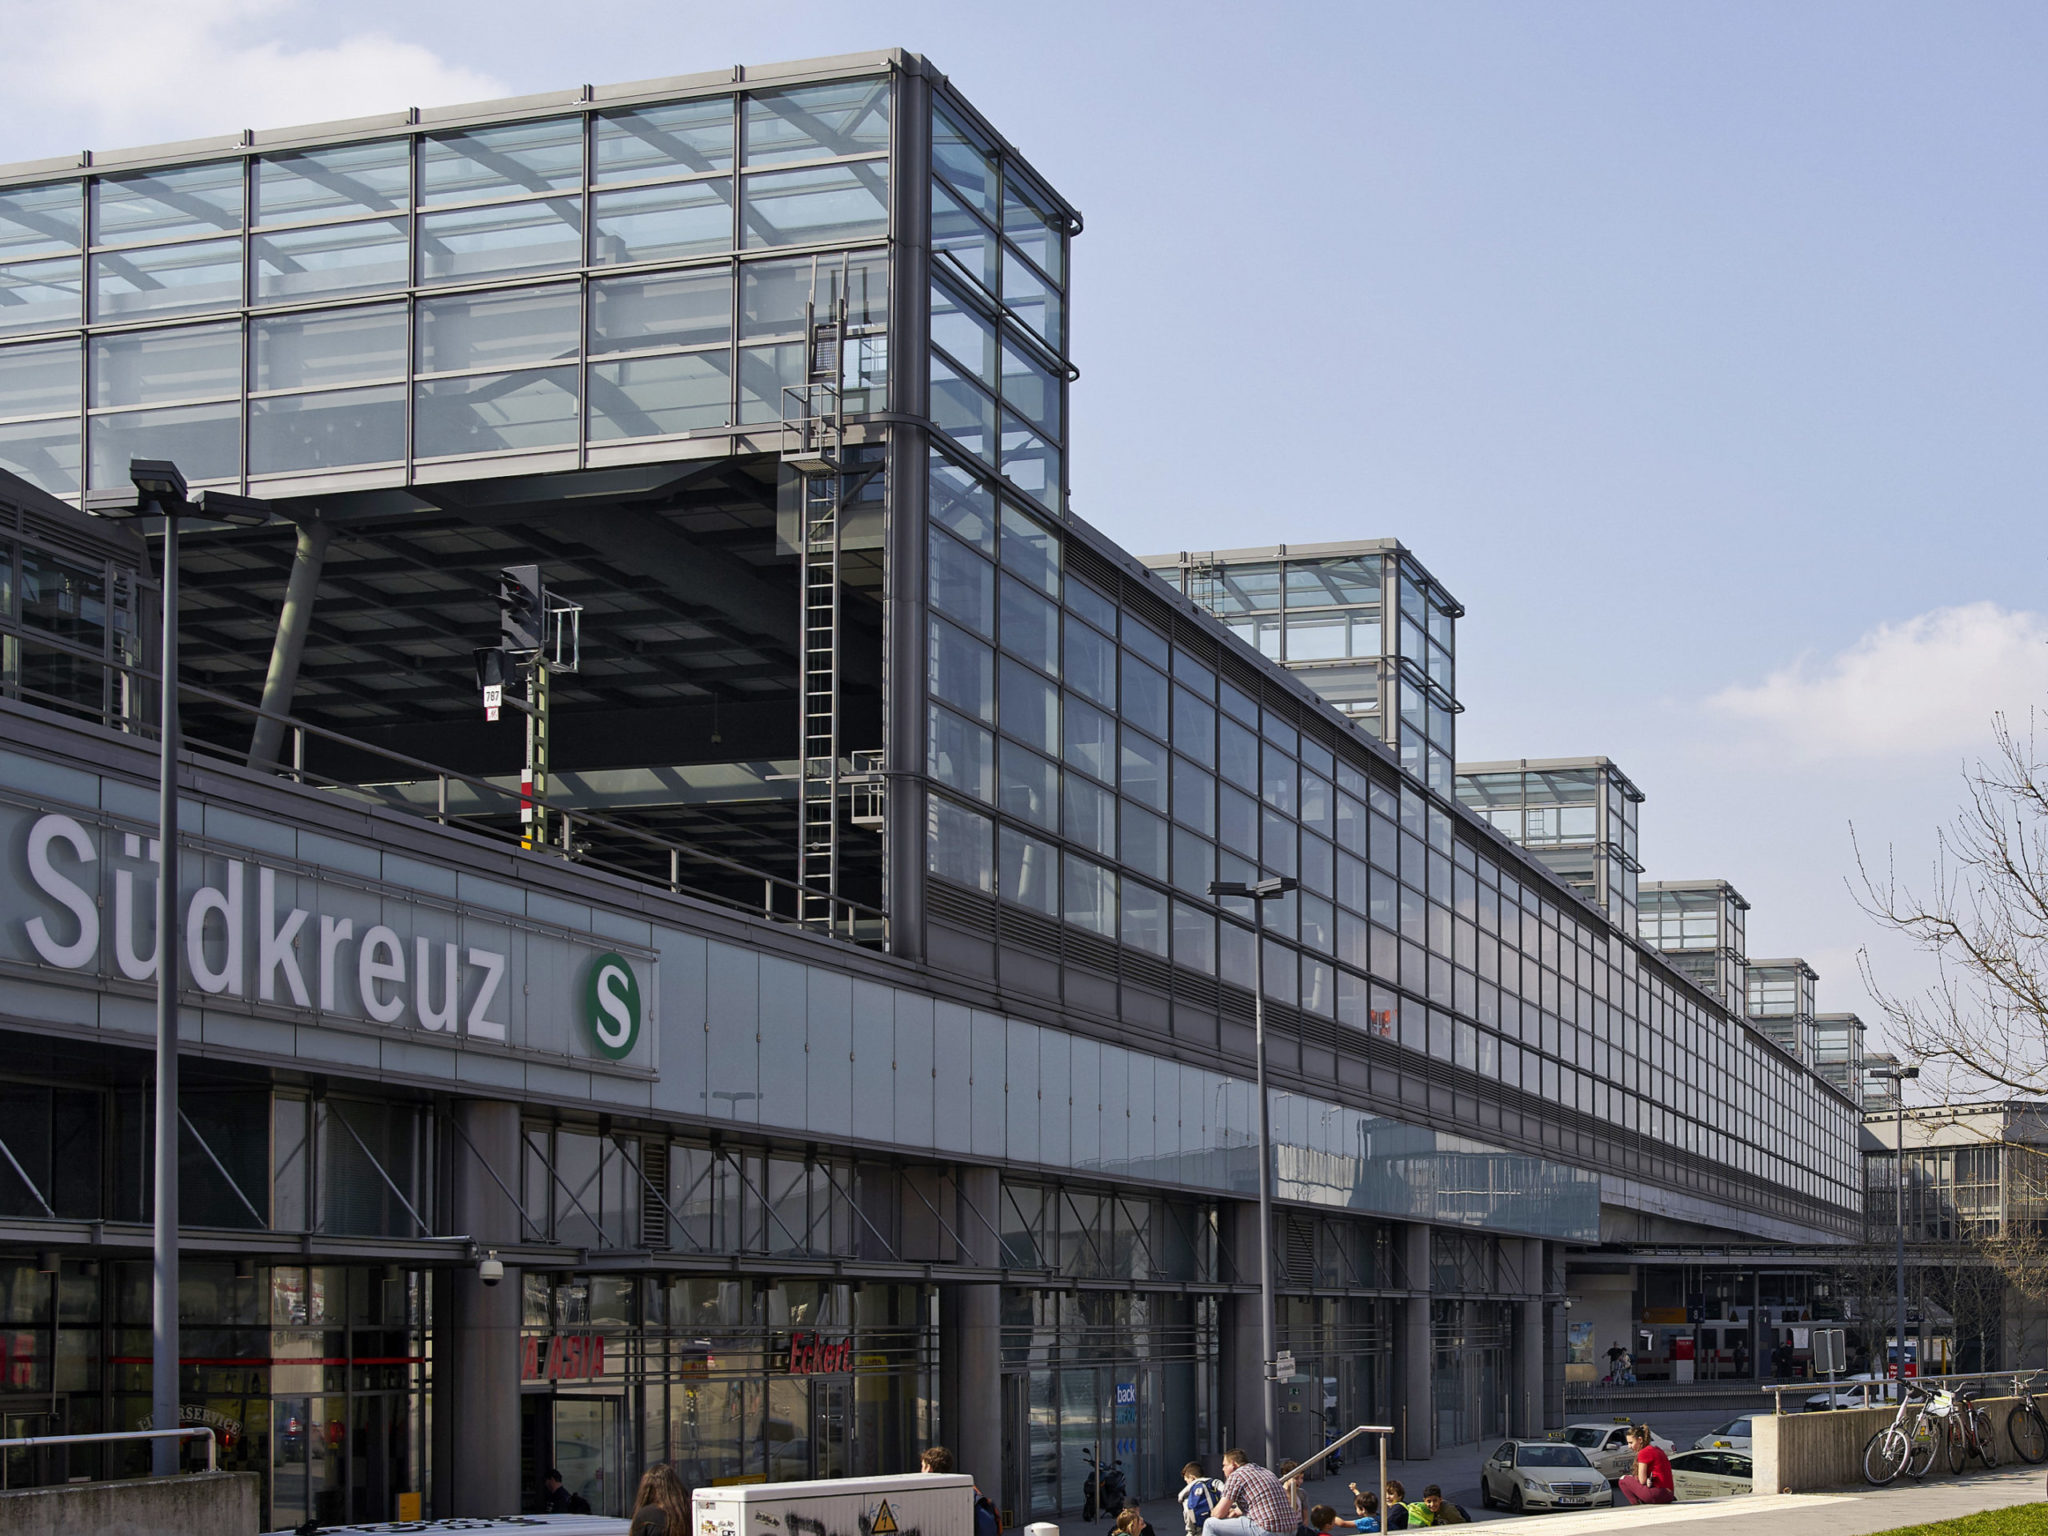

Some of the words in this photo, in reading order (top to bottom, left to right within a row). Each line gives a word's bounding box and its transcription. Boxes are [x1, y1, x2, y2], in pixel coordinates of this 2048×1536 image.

[486, 691, 500, 702] 787
[24, 813, 506, 1041] Südkreuz
[596, 964, 632, 1049] S
[546, 1335, 604, 1379] ASIA
[1117, 1385, 1136, 1404] back
[137, 1405, 242, 1435] LIRSERVICE
